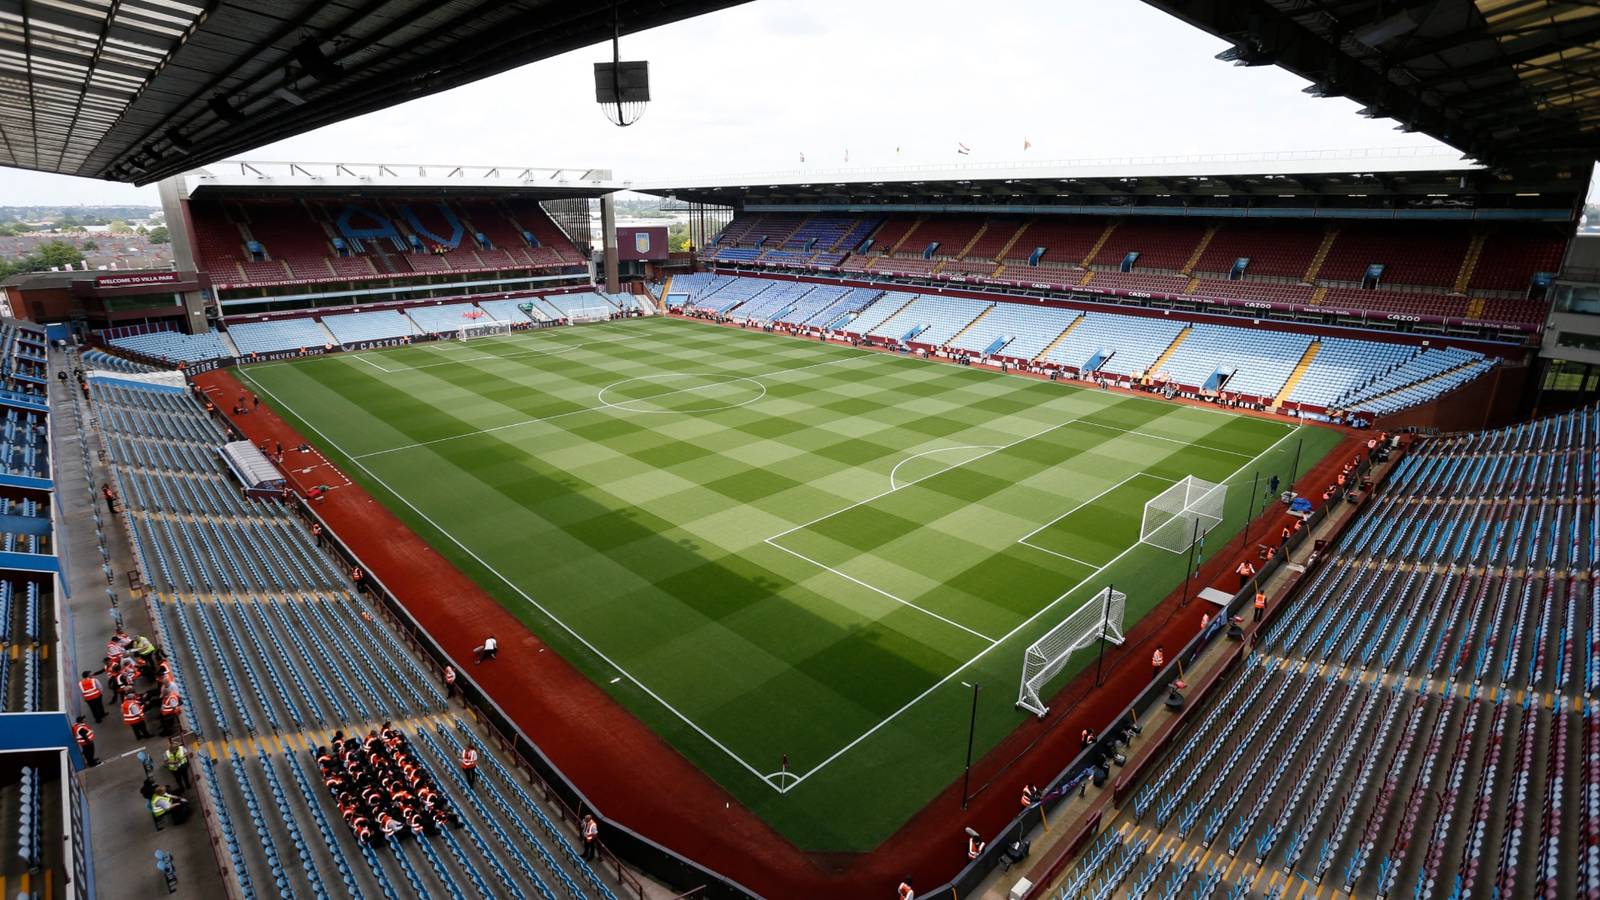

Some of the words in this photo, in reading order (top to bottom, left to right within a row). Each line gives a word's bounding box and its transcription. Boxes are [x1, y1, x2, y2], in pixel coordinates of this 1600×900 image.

[99, 277, 131, 285] WELCOME
[1244, 301, 1272, 309] CAZOO
[1386, 313, 1421, 322] CAZOO
[360, 337, 412, 351] CASTORE
[269, 351, 296, 361] NEVER
[298, 348, 324, 358] STOPS
[185, 360, 219, 376] ASTORE
